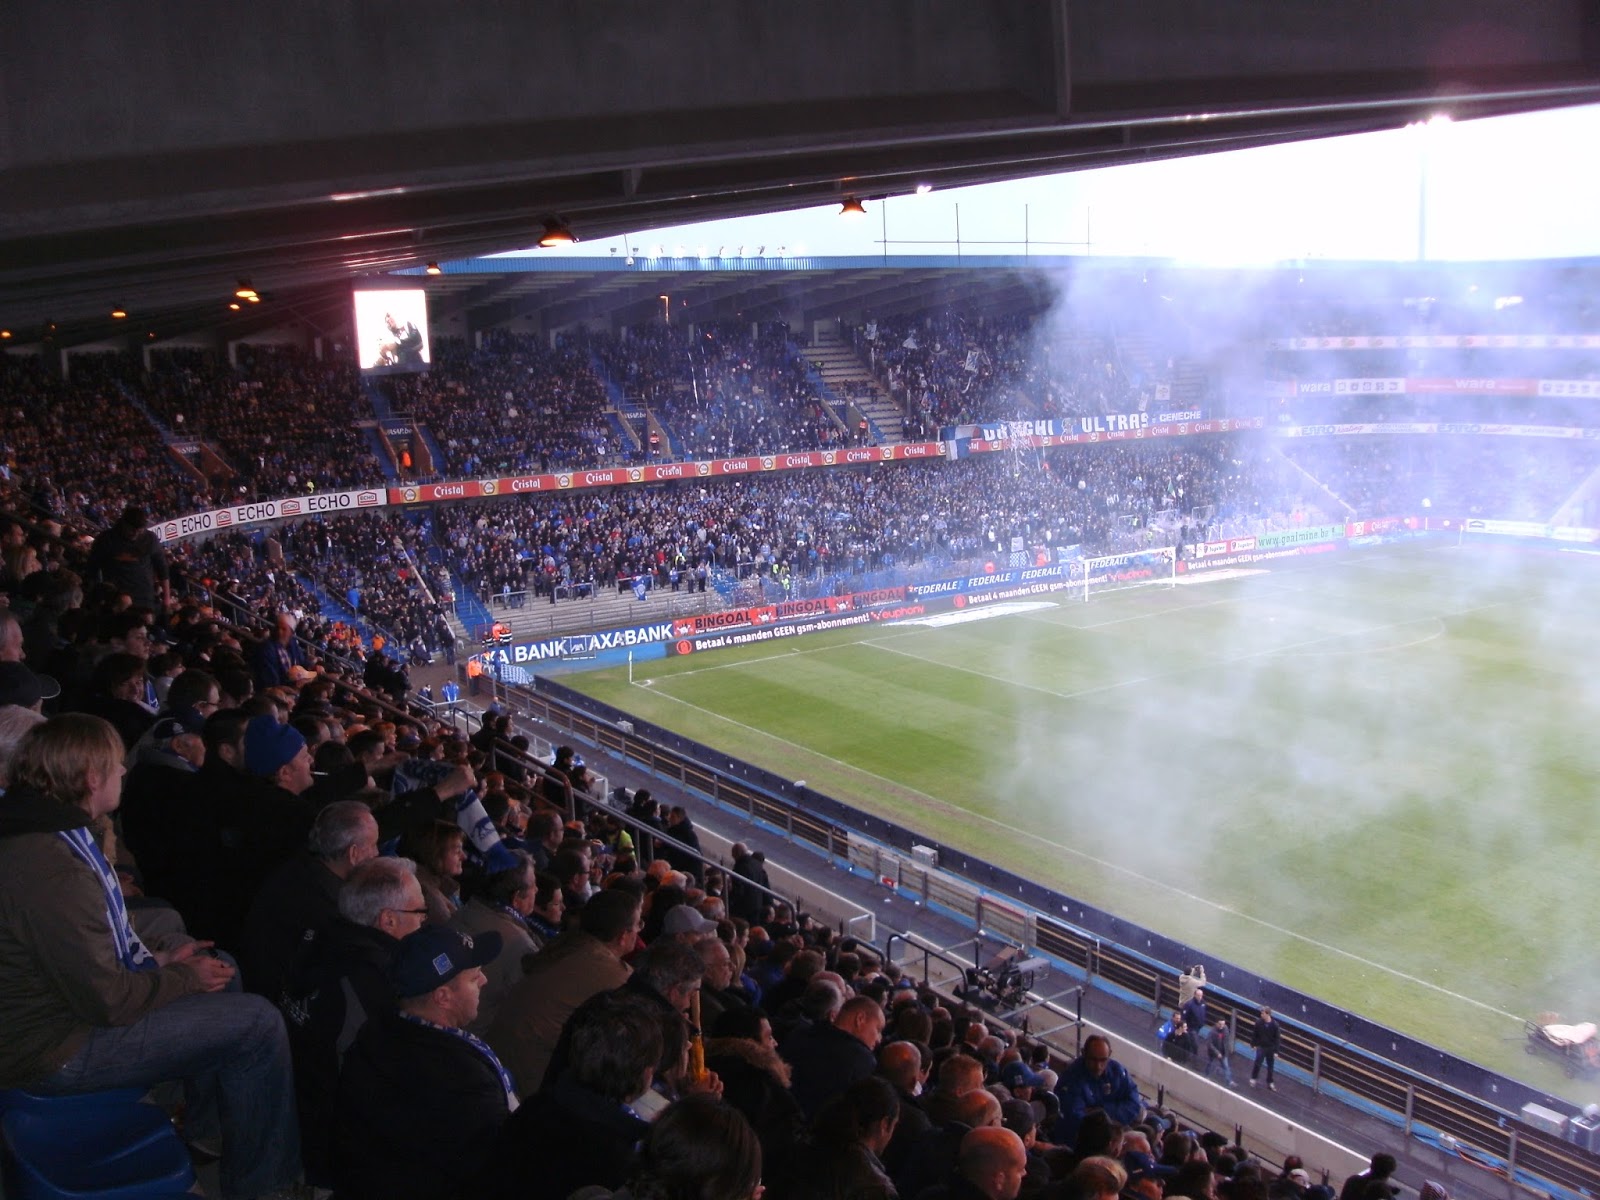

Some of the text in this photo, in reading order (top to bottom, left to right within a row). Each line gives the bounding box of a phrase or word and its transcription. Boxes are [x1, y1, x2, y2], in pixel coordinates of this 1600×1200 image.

[1455, 379, 1496, 389] wara
[1081, 412, 1149, 433] ULTRAS
[903, 445, 926, 457] Cristal
[656, 466, 683, 478] Cristal
[722, 460, 748, 472] Cristal
[512, 478, 541, 491] Cristal
[585, 472, 613, 485] Cristal
[434, 485, 464, 498] Cristal
[308, 494, 351, 511] ECHO
[237, 503, 276, 522] ECHO
[181, 514, 211, 534] ECHO
[1090, 556, 1128, 569] FEDERALE
[1021, 566, 1062, 580] FEDERALE
[968, 575, 1010, 587] FEDERALE
[968, 591, 993, 605] Betaal
[992, 591, 998, 600] 4
[998, 586, 1031, 598] maanden
[1031, 582, 1049, 593] GEEN
[881, 604, 925, 618] euphony
[695, 611, 752, 629] BINGOAL
[695, 612, 870, 651] Betaal 4 maanden GEEN gsm-abonnement!
[514, 639, 570, 663] BANK
